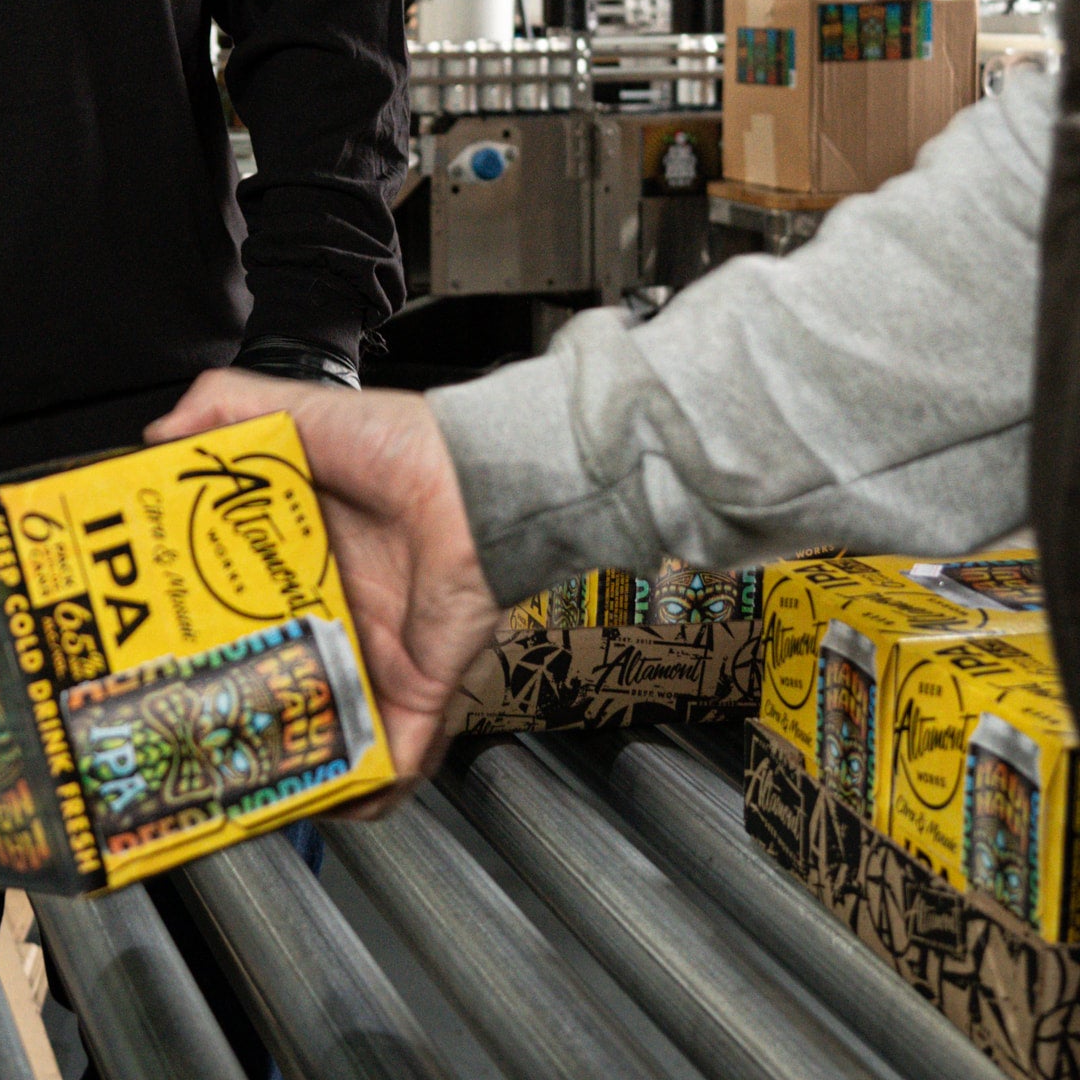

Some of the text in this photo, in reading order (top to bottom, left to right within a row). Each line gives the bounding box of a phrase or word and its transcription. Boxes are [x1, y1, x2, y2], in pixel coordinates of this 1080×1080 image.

[20, 510, 65, 543] 6
[83, 511, 151, 648] IPA
[177, 447, 333, 620] Altamont
[592, 645, 712, 694] Altamont
[3, 593, 45, 674] COLD
[27, 677, 75, 778] DRINK
[55, 781, 101, 875] FRESH
[88, 722, 149, 815] IPA
